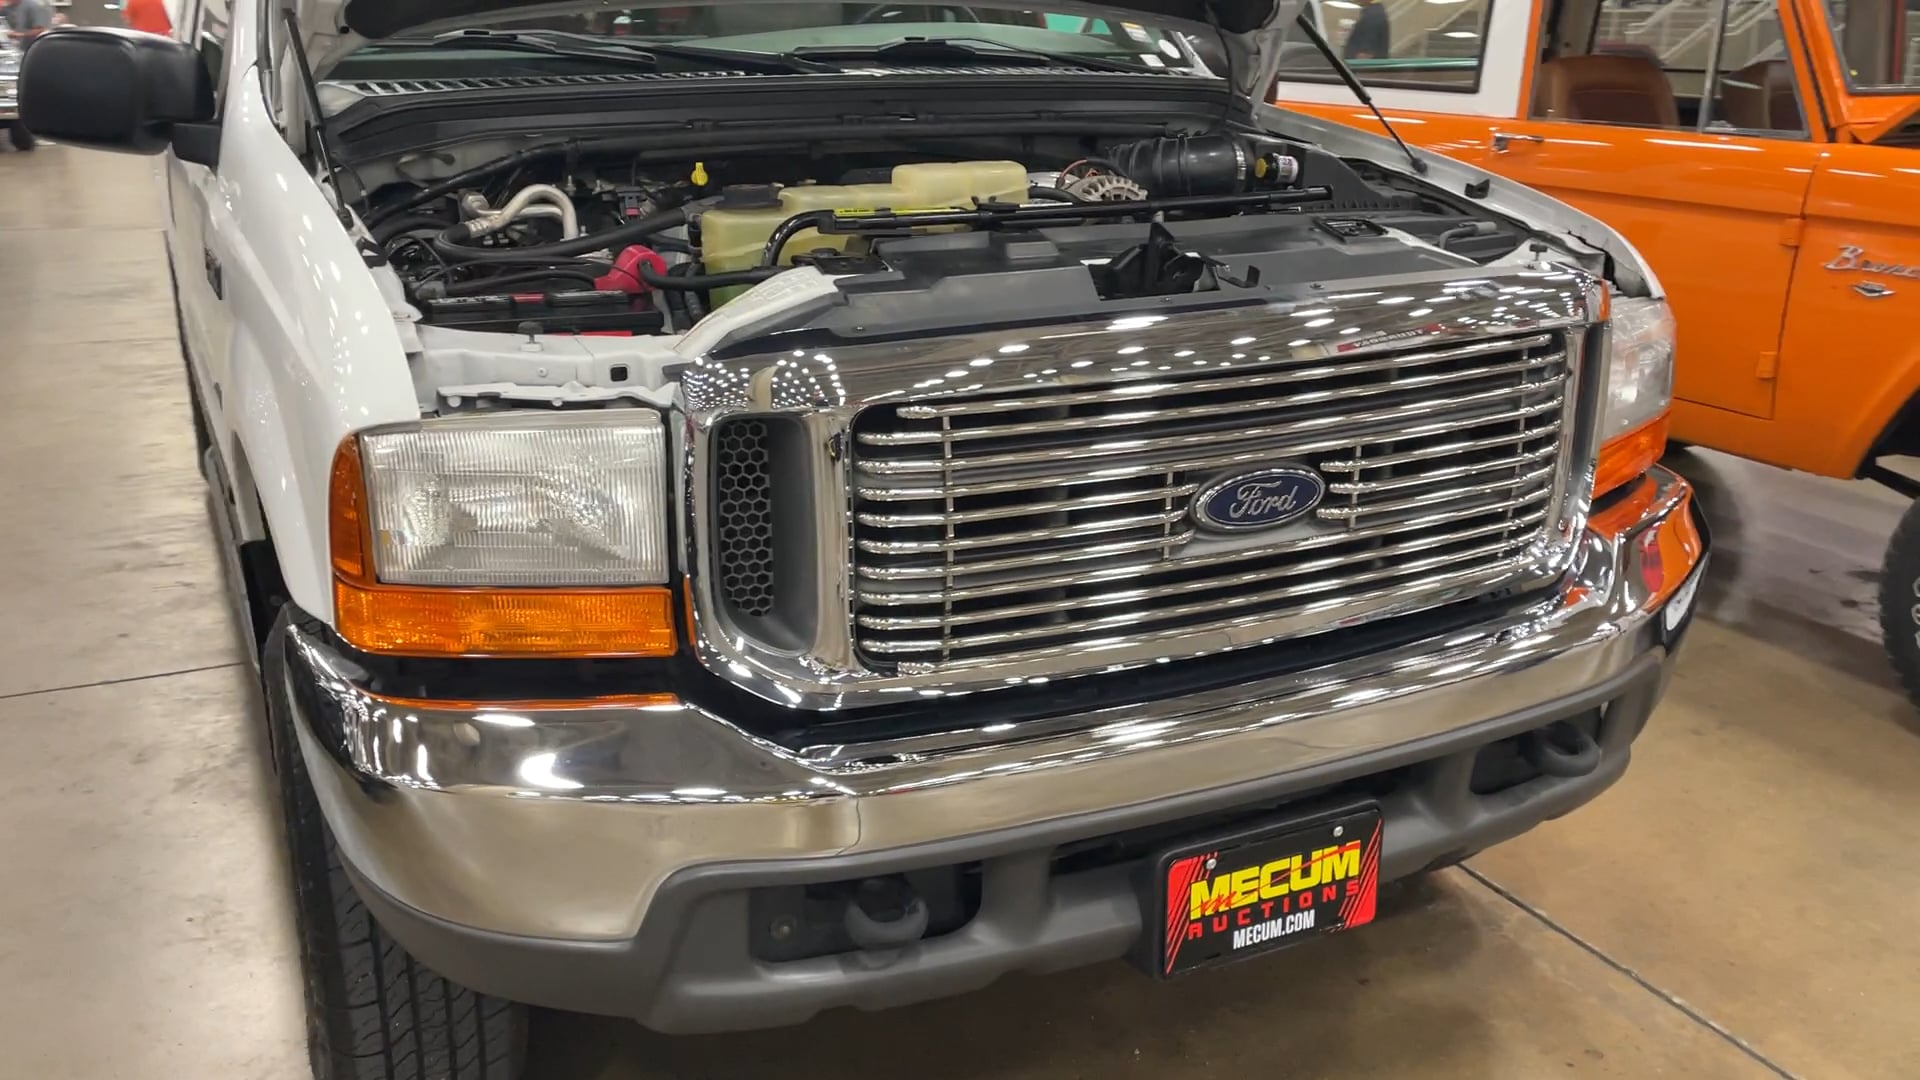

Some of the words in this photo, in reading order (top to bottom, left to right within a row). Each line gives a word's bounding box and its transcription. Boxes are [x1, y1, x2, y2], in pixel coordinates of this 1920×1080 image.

[1229, 480, 1299, 518] Ford
[1190, 840, 1361, 920] MECUM
[1188, 880, 1360, 940] AUCTIONS
[1233, 909, 1315, 950] MECUM.COM
